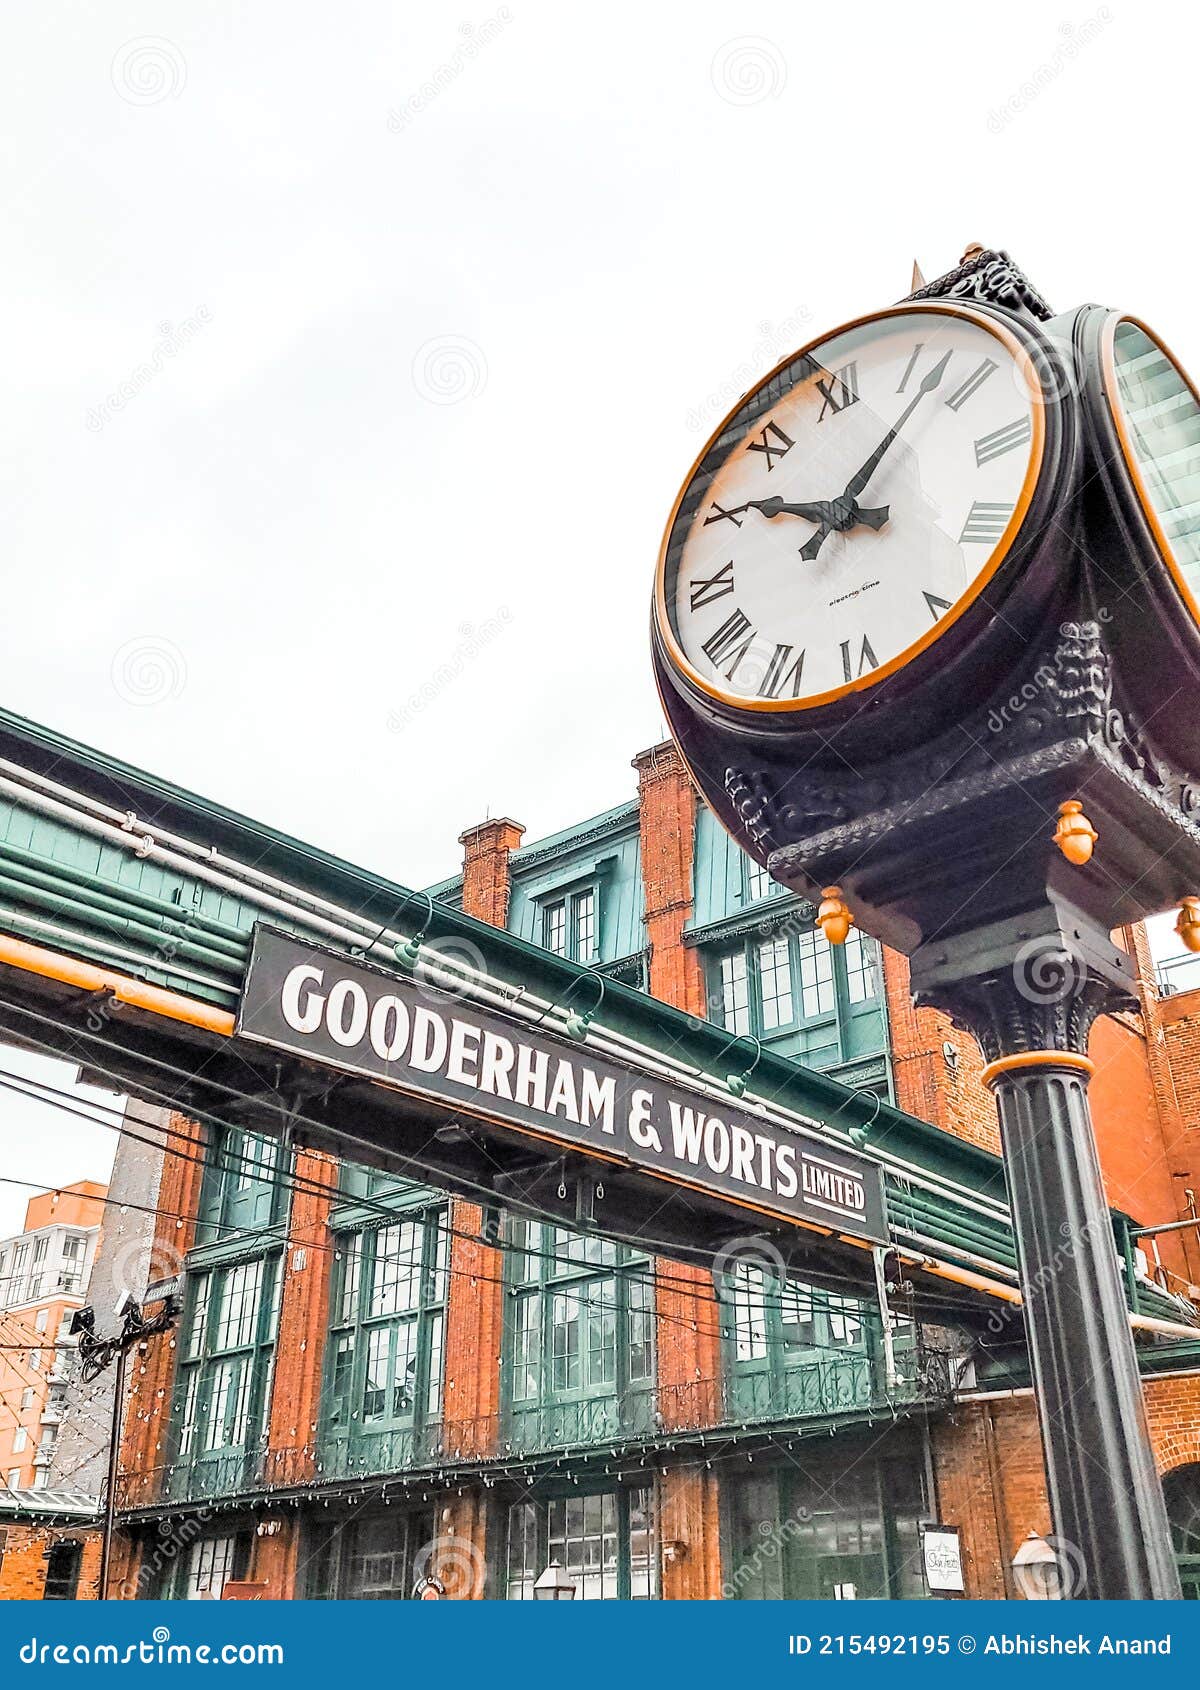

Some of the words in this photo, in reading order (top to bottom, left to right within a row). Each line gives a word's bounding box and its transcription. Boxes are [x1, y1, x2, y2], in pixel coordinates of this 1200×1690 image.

[816, 360, 860, 424] XII
[944, 358, 1000, 412] II
[746, 419, 796, 472] XI
[974, 414, 1031, 468] III
[703, 501, 750, 528] X
[690, 559, 734, 612] IX
[829, 590, 859, 606] electric
[861, 580, 880, 591] time
[281, 964, 616, 1136] GOODERHAM
[628, 1089, 663, 1153] &
[668, 1100, 798, 1198] WORTS
[802, 1163, 865, 1210] LIMITED
